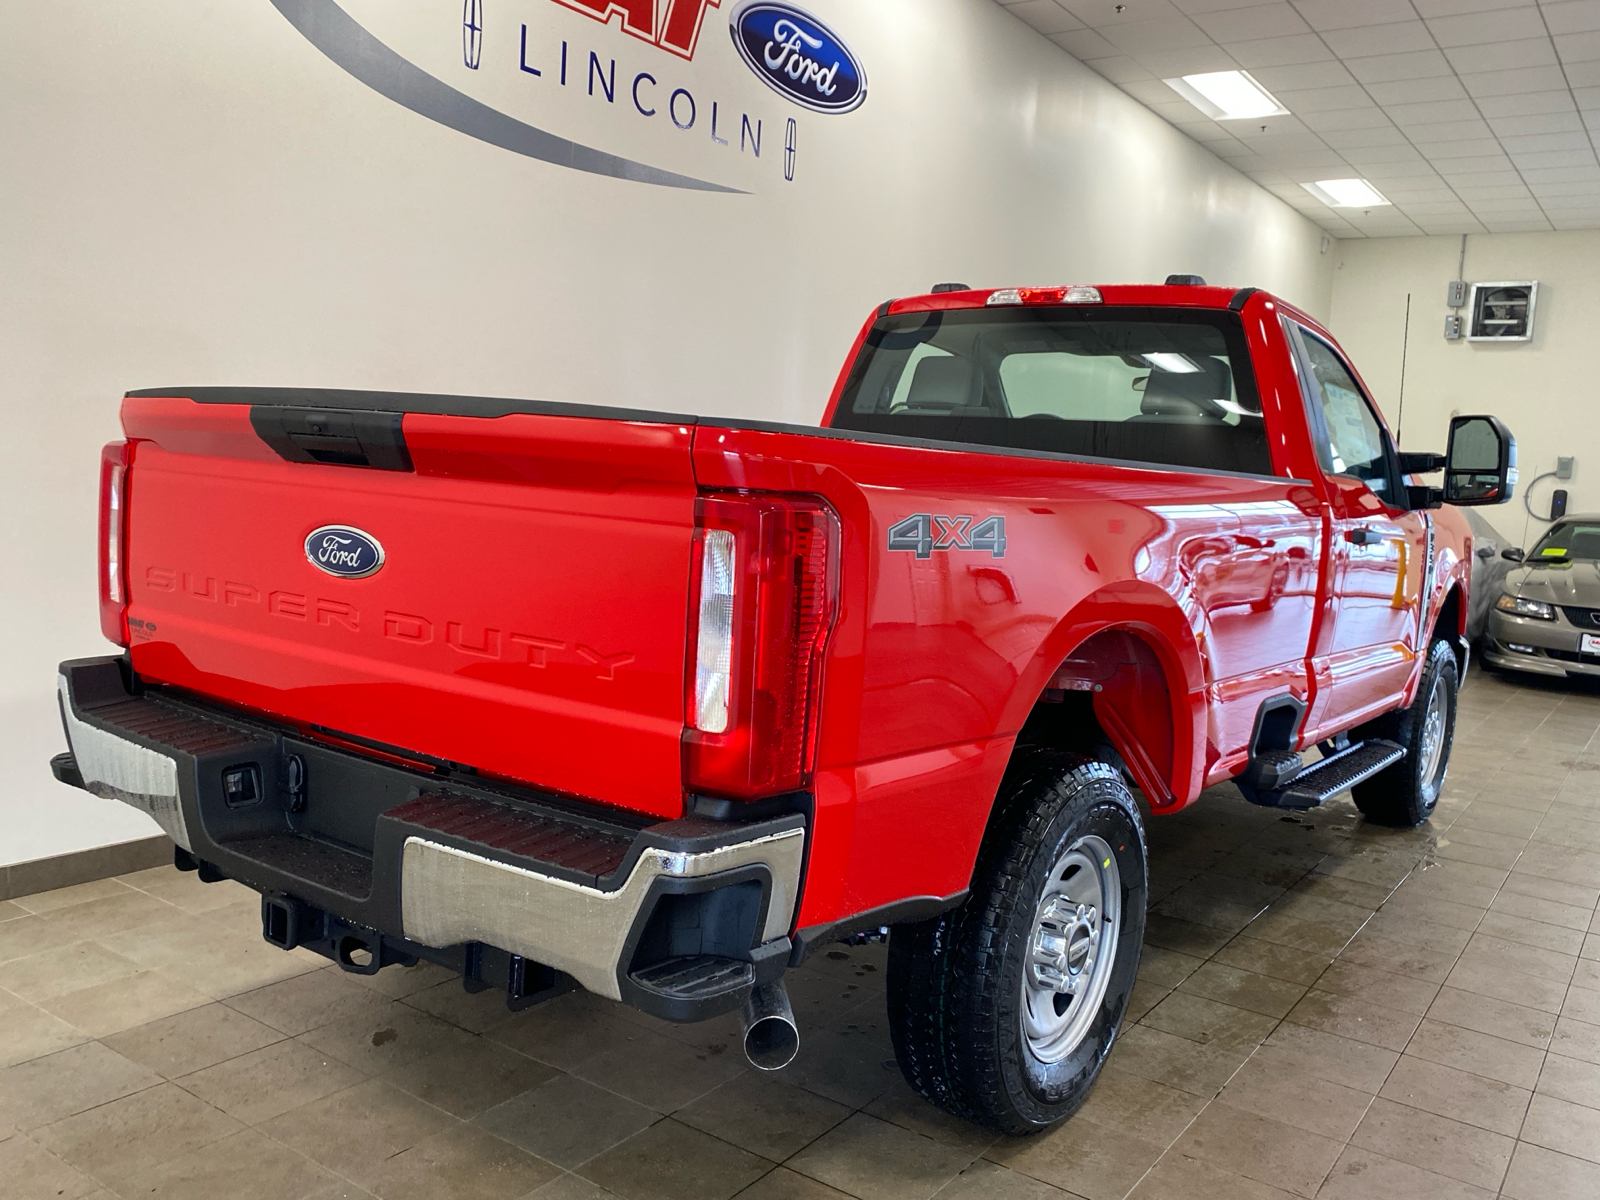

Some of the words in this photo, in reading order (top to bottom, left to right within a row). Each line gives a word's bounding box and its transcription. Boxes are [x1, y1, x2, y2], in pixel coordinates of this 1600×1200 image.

[520, 24, 762, 157] LINCOLN
[764, 19, 840, 97] Ford
[318, 535, 363, 567] Ford
[146, 566, 360, 632] SUPER
[384, 610, 635, 680] DUTY
